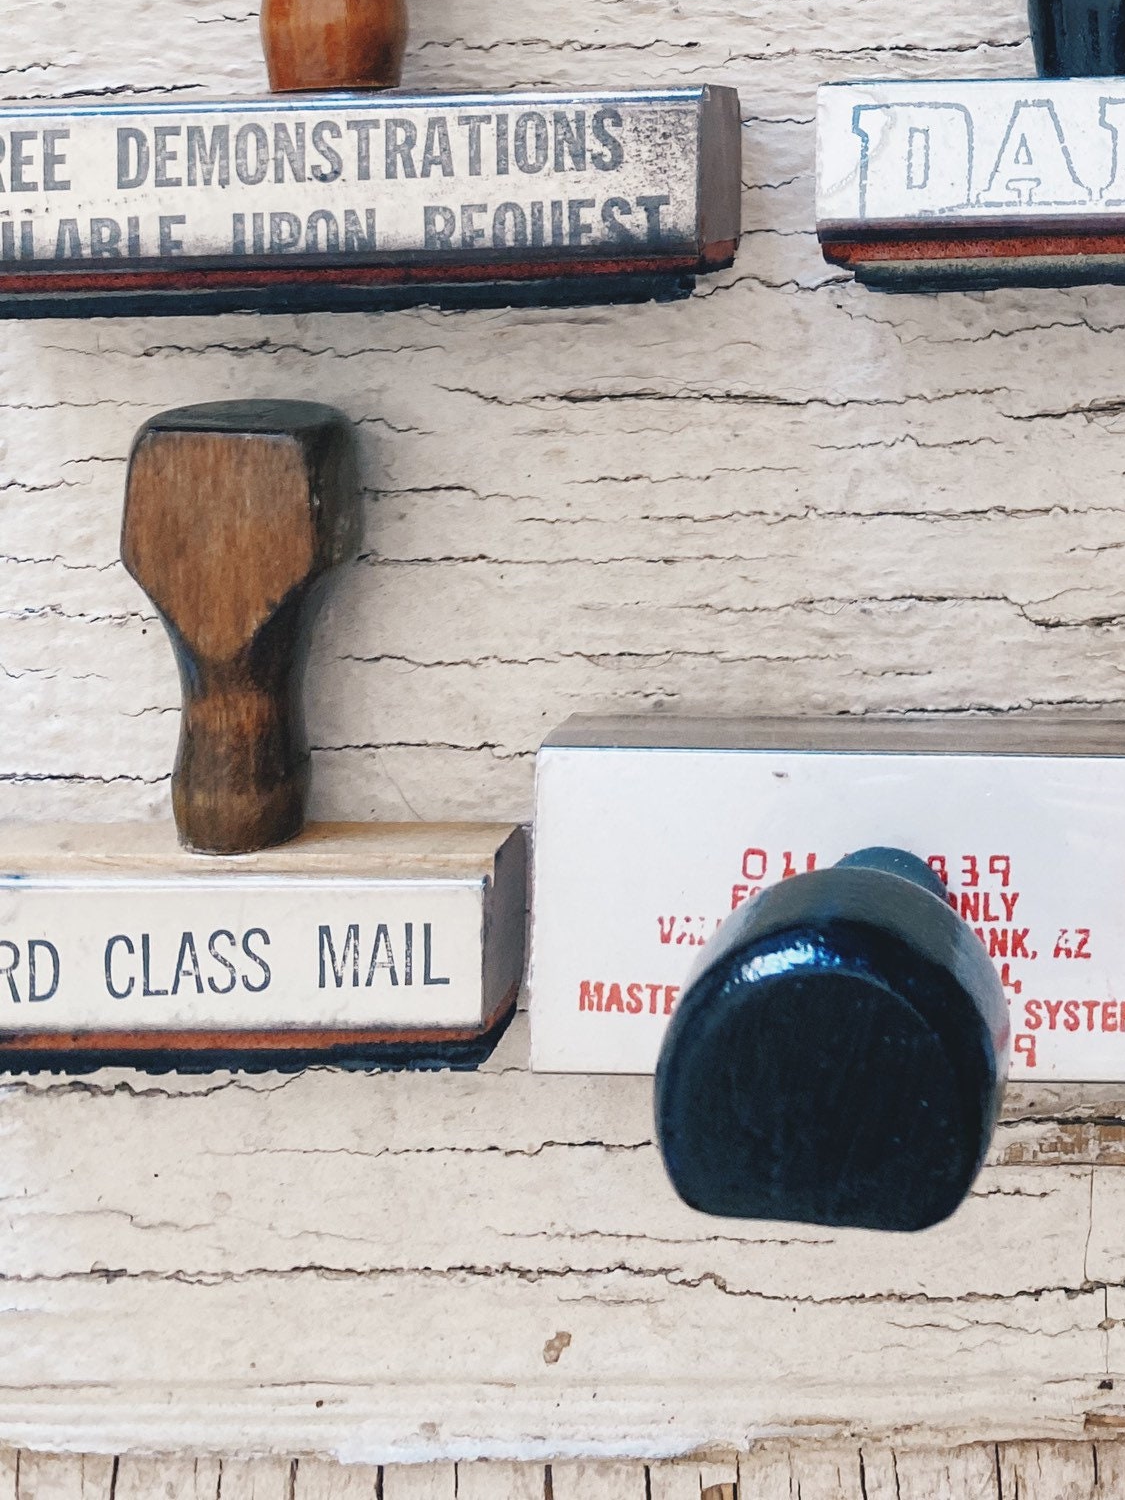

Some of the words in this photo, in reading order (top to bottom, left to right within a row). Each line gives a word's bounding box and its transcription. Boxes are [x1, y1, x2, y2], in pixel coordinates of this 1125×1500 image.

[0, 129, 71, 193] EE
[116, 103, 625, 190] DEMONSTRATIONS
[105, 927, 271, 1000] CLASS
[318, 922, 451, 988] MAIL
